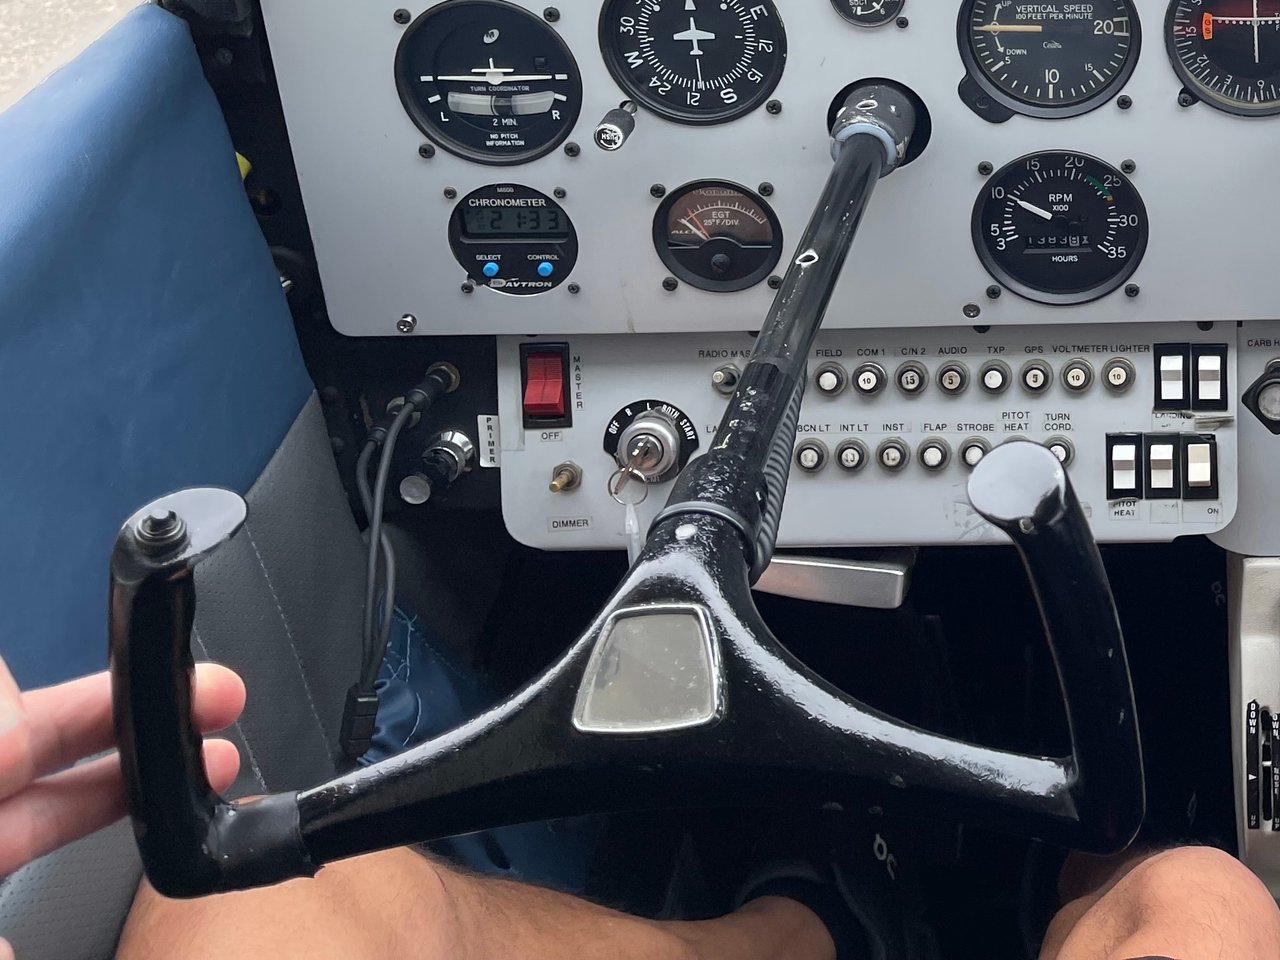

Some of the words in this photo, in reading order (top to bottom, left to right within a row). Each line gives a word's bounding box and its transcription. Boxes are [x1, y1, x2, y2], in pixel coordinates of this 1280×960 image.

[750, 5, 769, 21] E
[1016, 5, 1058, 13] VERTICAL
[1064, 5, 1093, 13] SPEED
[620, 17, 635, 36] 30
[1094, 20, 1114, 35] 20
[720, 88, 738, 104] S
[992, 187, 1005, 199] 10
[1049, 194, 1072, 202] RPM
[469, 199, 546, 207] CHRONOMETER
[1119, 215, 1139, 226] 30
[1108, 247, 1127, 259] 35
[490, 278, 552, 288] DAVTRON
[699, 350, 729, 358] RADIO
[1053, 345, 1109, 353] VOLTMETER
[573, 356, 583, 409] MASTER
[1002, 412, 1030, 420] PITOT
[680, 419, 696, 440] START
[819, 424, 831, 432] LT
[1005, 423, 1029, 431] HEAT
[487, 417, 496, 463] PRIMER
[541, 432, 560, 440] OFF
[553, 520, 589, 528] DIMMER
[1248, 702, 1258, 735] DOWN
